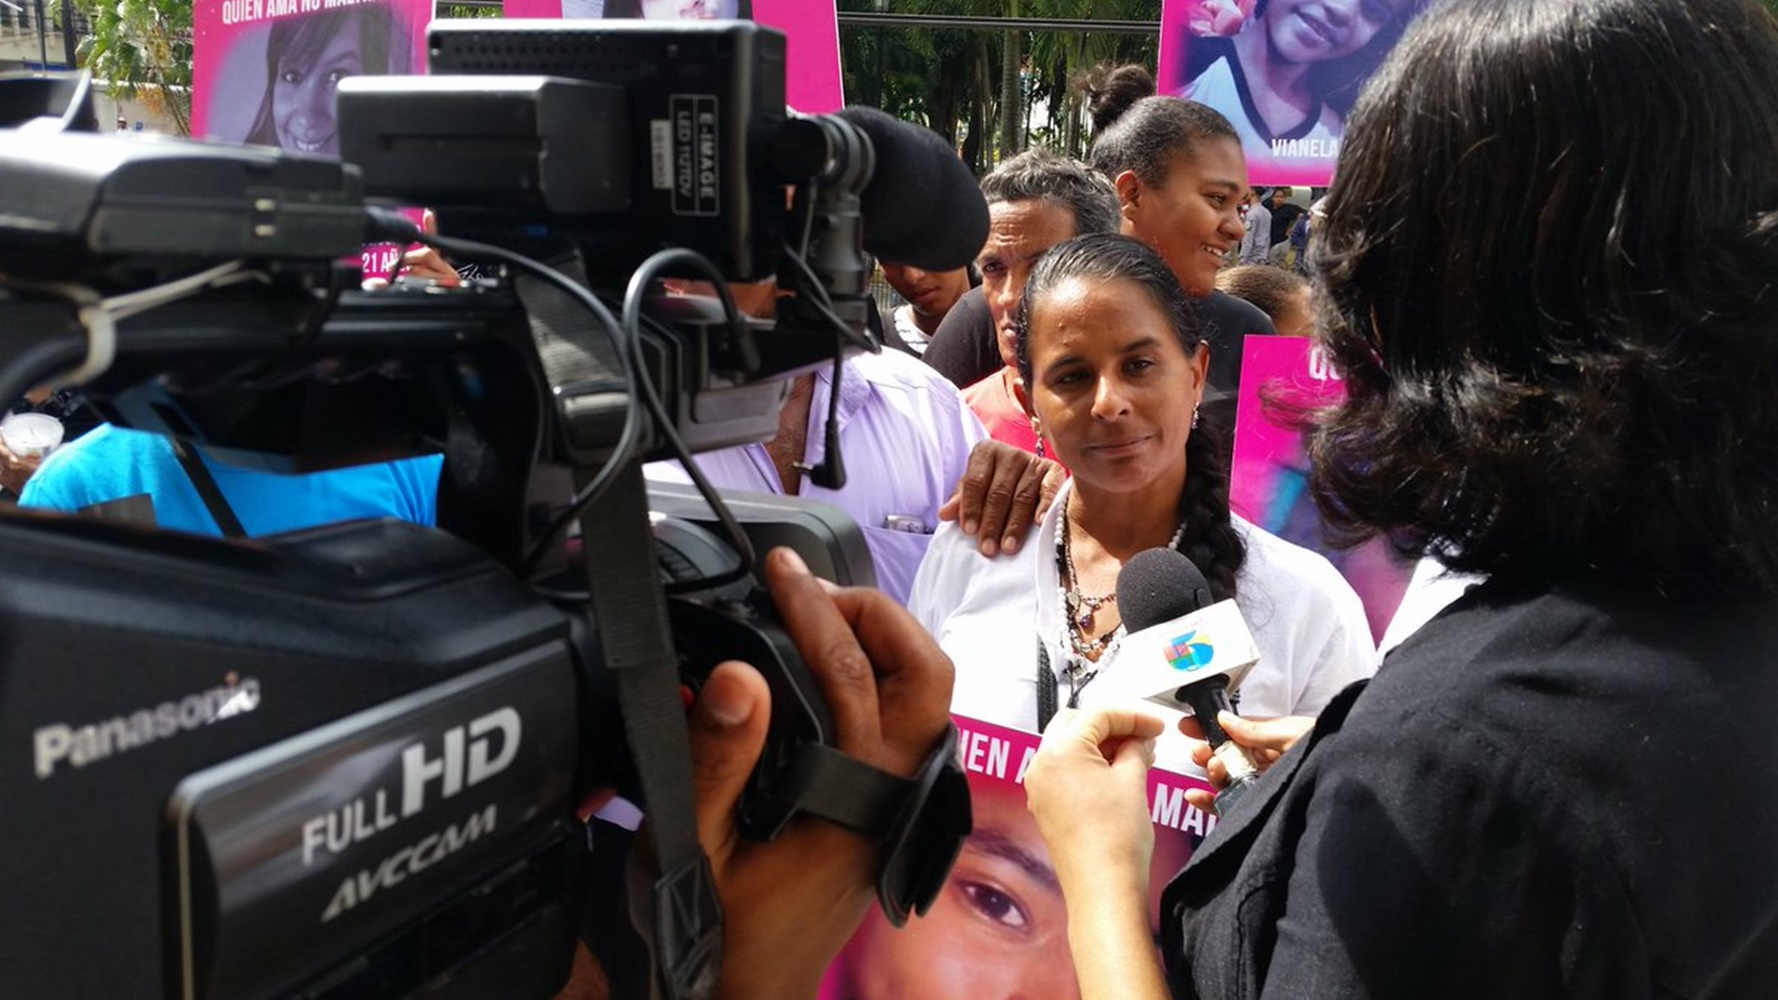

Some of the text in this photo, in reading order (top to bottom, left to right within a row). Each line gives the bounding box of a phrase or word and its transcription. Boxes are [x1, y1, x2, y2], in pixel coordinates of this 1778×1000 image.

[222, 0, 262, 24] QUIEN
[267, 0, 298, 18] AMA
[678, 111, 692, 142] LED
[699, 112, 714, 198] E-IMAGE
[1272, 139, 1340, 157] VIANELA
[362, 252, 377, 273] 21
[34, 670, 261, 780] Panasonic
[303, 706, 522, 866] FULL HD
[321, 803, 497, 922] AVCCAM
